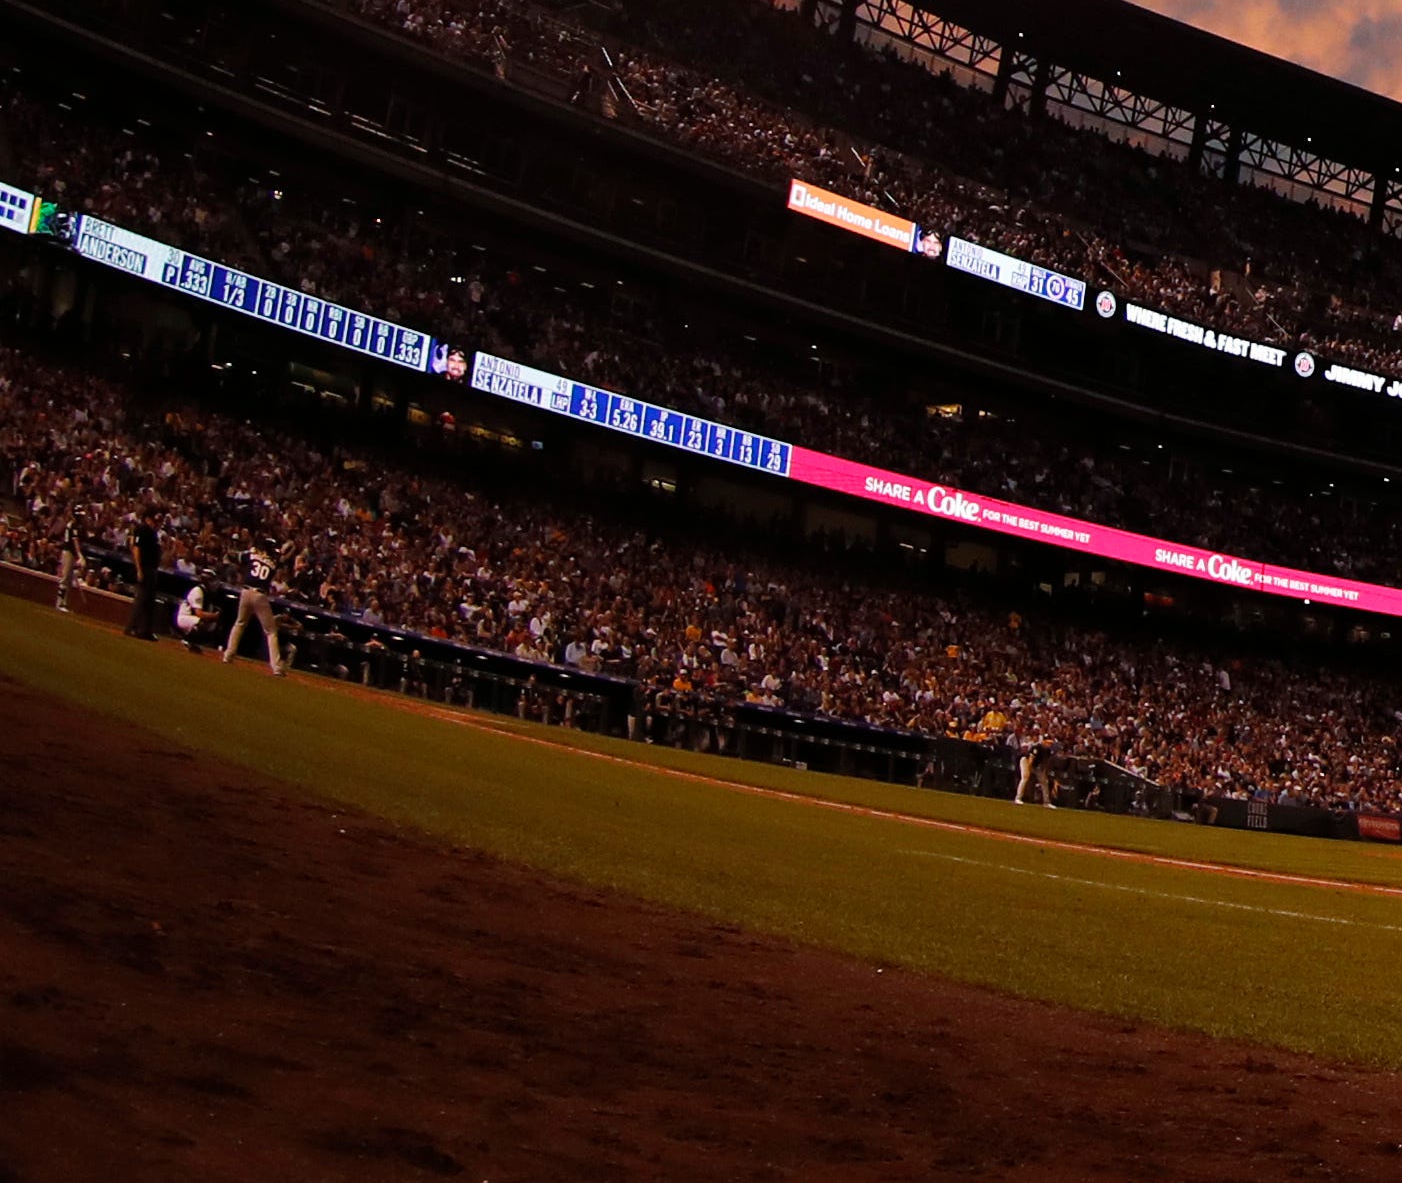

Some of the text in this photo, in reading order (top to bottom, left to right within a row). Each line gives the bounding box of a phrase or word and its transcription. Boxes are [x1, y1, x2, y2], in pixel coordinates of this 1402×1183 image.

[806, 193, 910, 243] Ideal Home Loans
[79, 235, 145, 273] ANDERSON
[223, 285, 245, 307] 1/3
[1031, 277, 1044, 294] 31
[1065, 289, 1079, 306] 45
[1126, 303, 1167, 333] WHERE
[1167, 317, 1204, 344] FRESH
[1204, 329, 1216, 349] &
[1217, 334, 1250, 357] FAST
[1250, 343, 1287, 367] MEET
[475, 369, 540, 404] SENZATELA
[1325, 365, 1386, 392] JIMMY
[579, 399, 598, 419] 3-3
[612, 408, 638, 431] 5.26
[650, 419, 674, 442] 39.1
[687, 431, 702, 449] 23
[739, 445, 752, 463] 13
[767, 453, 781, 471] 29
[864, 476, 911, 502] SHARE
[914, 489, 925, 506] A
[927, 486, 980, 521] Coke
[982, 509, 1001, 522] FOR
[1002, 513, 1018, 526] THE
[1018, 517, 1040, 531] BEST
[1074, 531, 1091, 543] YET
[251, 561, 270, 580] 30
[1155, 548, 1194, 569] SHARE
[1196, 559, 1206, 572] A
[1207, 555, 1252, 585] Coke
[1254, 573, 1272, 585] FOR
[1273, 576, 1289, 588] THE
[1289, 580, 1309, 591] BEST
[1342, 590, 1359, 601] YET
